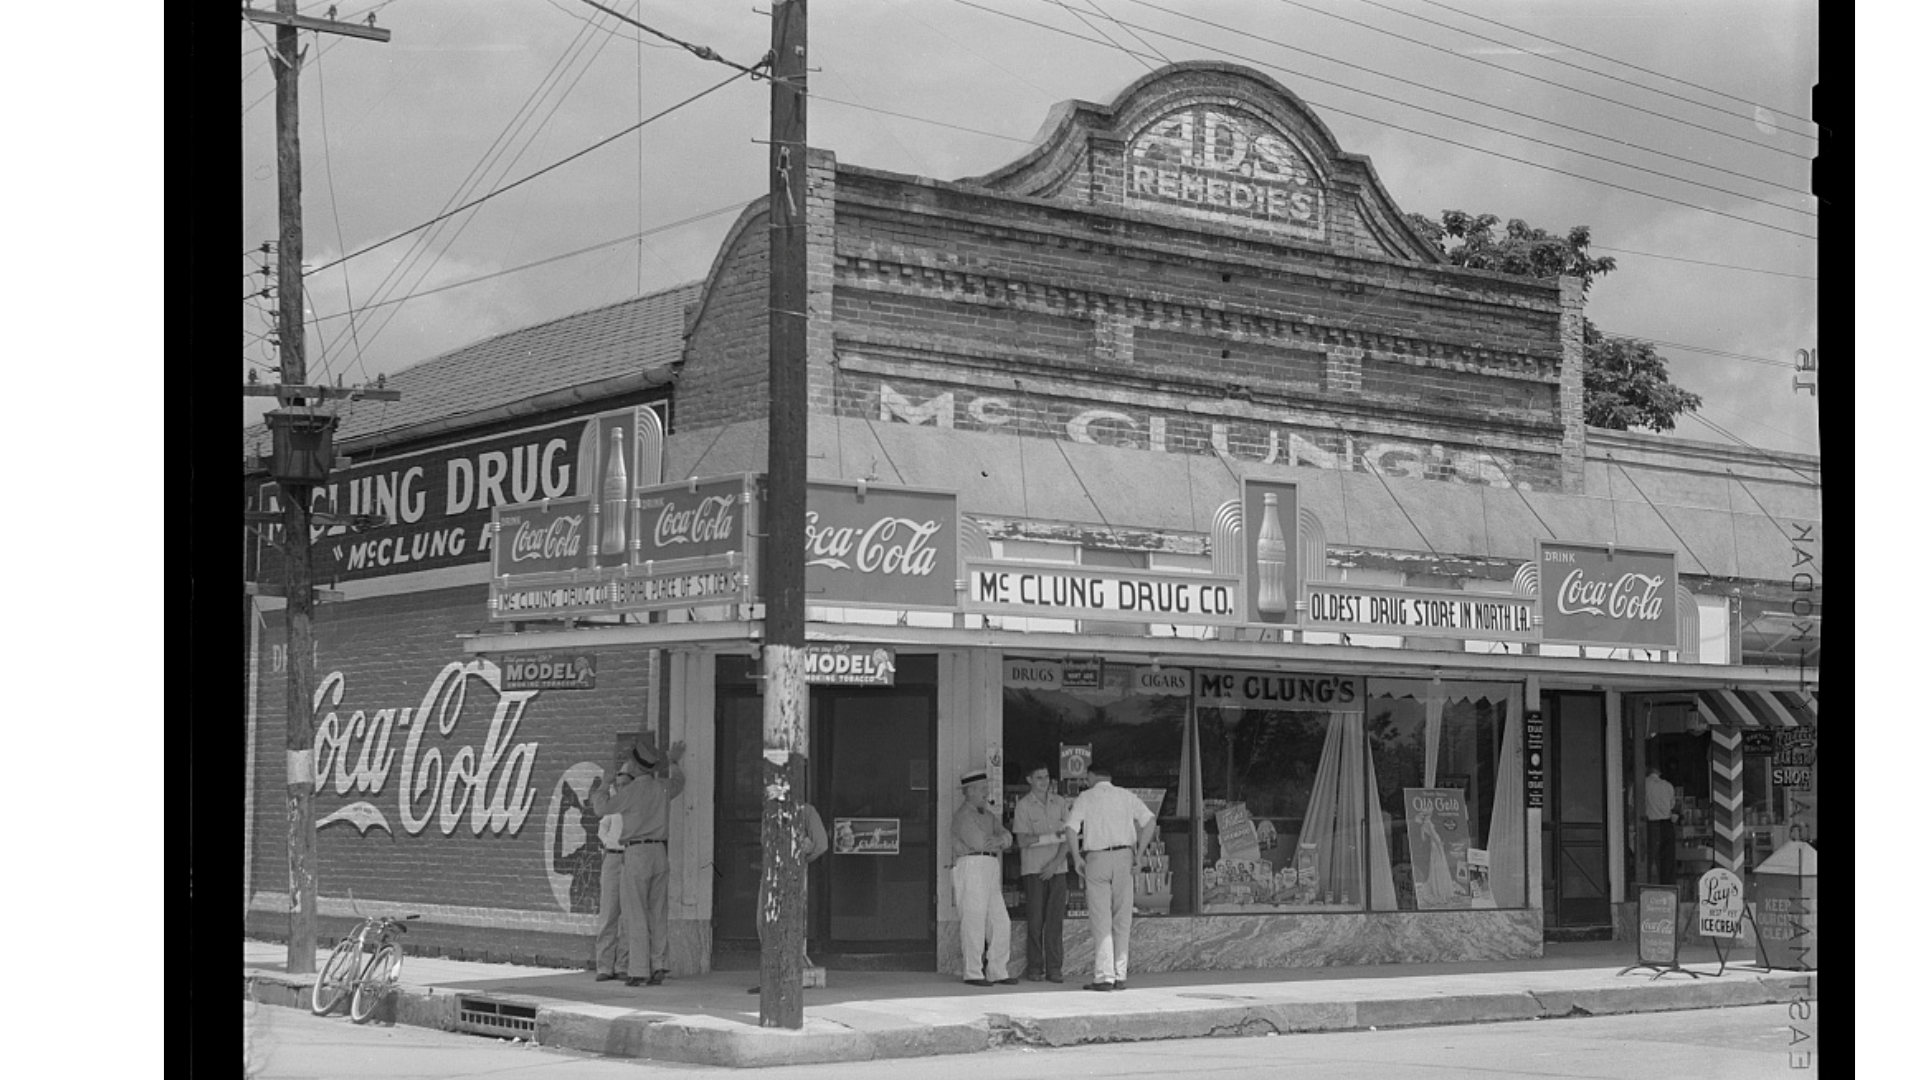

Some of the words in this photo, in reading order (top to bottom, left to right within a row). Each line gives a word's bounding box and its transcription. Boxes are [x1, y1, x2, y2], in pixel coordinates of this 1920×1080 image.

[1133, 164, 1312, 221] REMEDIES
[268, 465, 427, 546] MCLUNG
[446, 438, 570, 516] DRUG
[654, 494, 737, 547] Coca-Cola
[512, 513, 585, 562] Coca-Cola
[806, 510, 943, 577] oca-Cola
[1544, 551, 1576, 563] DRINK
[980, 572, 1009, 602] Mc
[1020, 575, 1104, 609] CLUNG
[1118, 580, 1189, 613] DRUG
[1200, 586, 1233, 615] CO.
[1557, 568, 1666, 620] Coca-Cola
[1311, 593, 1361, 622] OLDEST
[1370, 597, 1407, 625] DRUG
[1413, 600, 1456, 628] STORE
[1459, 602, 1471, 629] IN
[1475, 602, 1510, 631] NORTH
[1514, 606, 1531, 632] LA.
[506, 663, 576, 681] MODEL
[804, 653, 876, 674] MODEL
[1012, 667, 1054, 682] DRUGS
[804, 674, 836, 682] MOKING
[839, 675, 875, 683] TOBACCO
[1141, 673, 1186, 689] CIGARS
[1201, 674, 1234, 698] Mc
[1243, 676, 1355, 703] CLUNG'S
[314, 659, 542, 836] oca-Cola
[1773, 769, 1810, 785] SHOP
[1412, 797, 1433, 812] Old
[1435, 798, 1460, 812] Gold
[1701, 876, 1739, 909] Lay's
[1765, 898, 1791, 912] KEEP
[1701, 918, 1714, 932] ICE
[1715, 919, 1742, 935] CREAM
